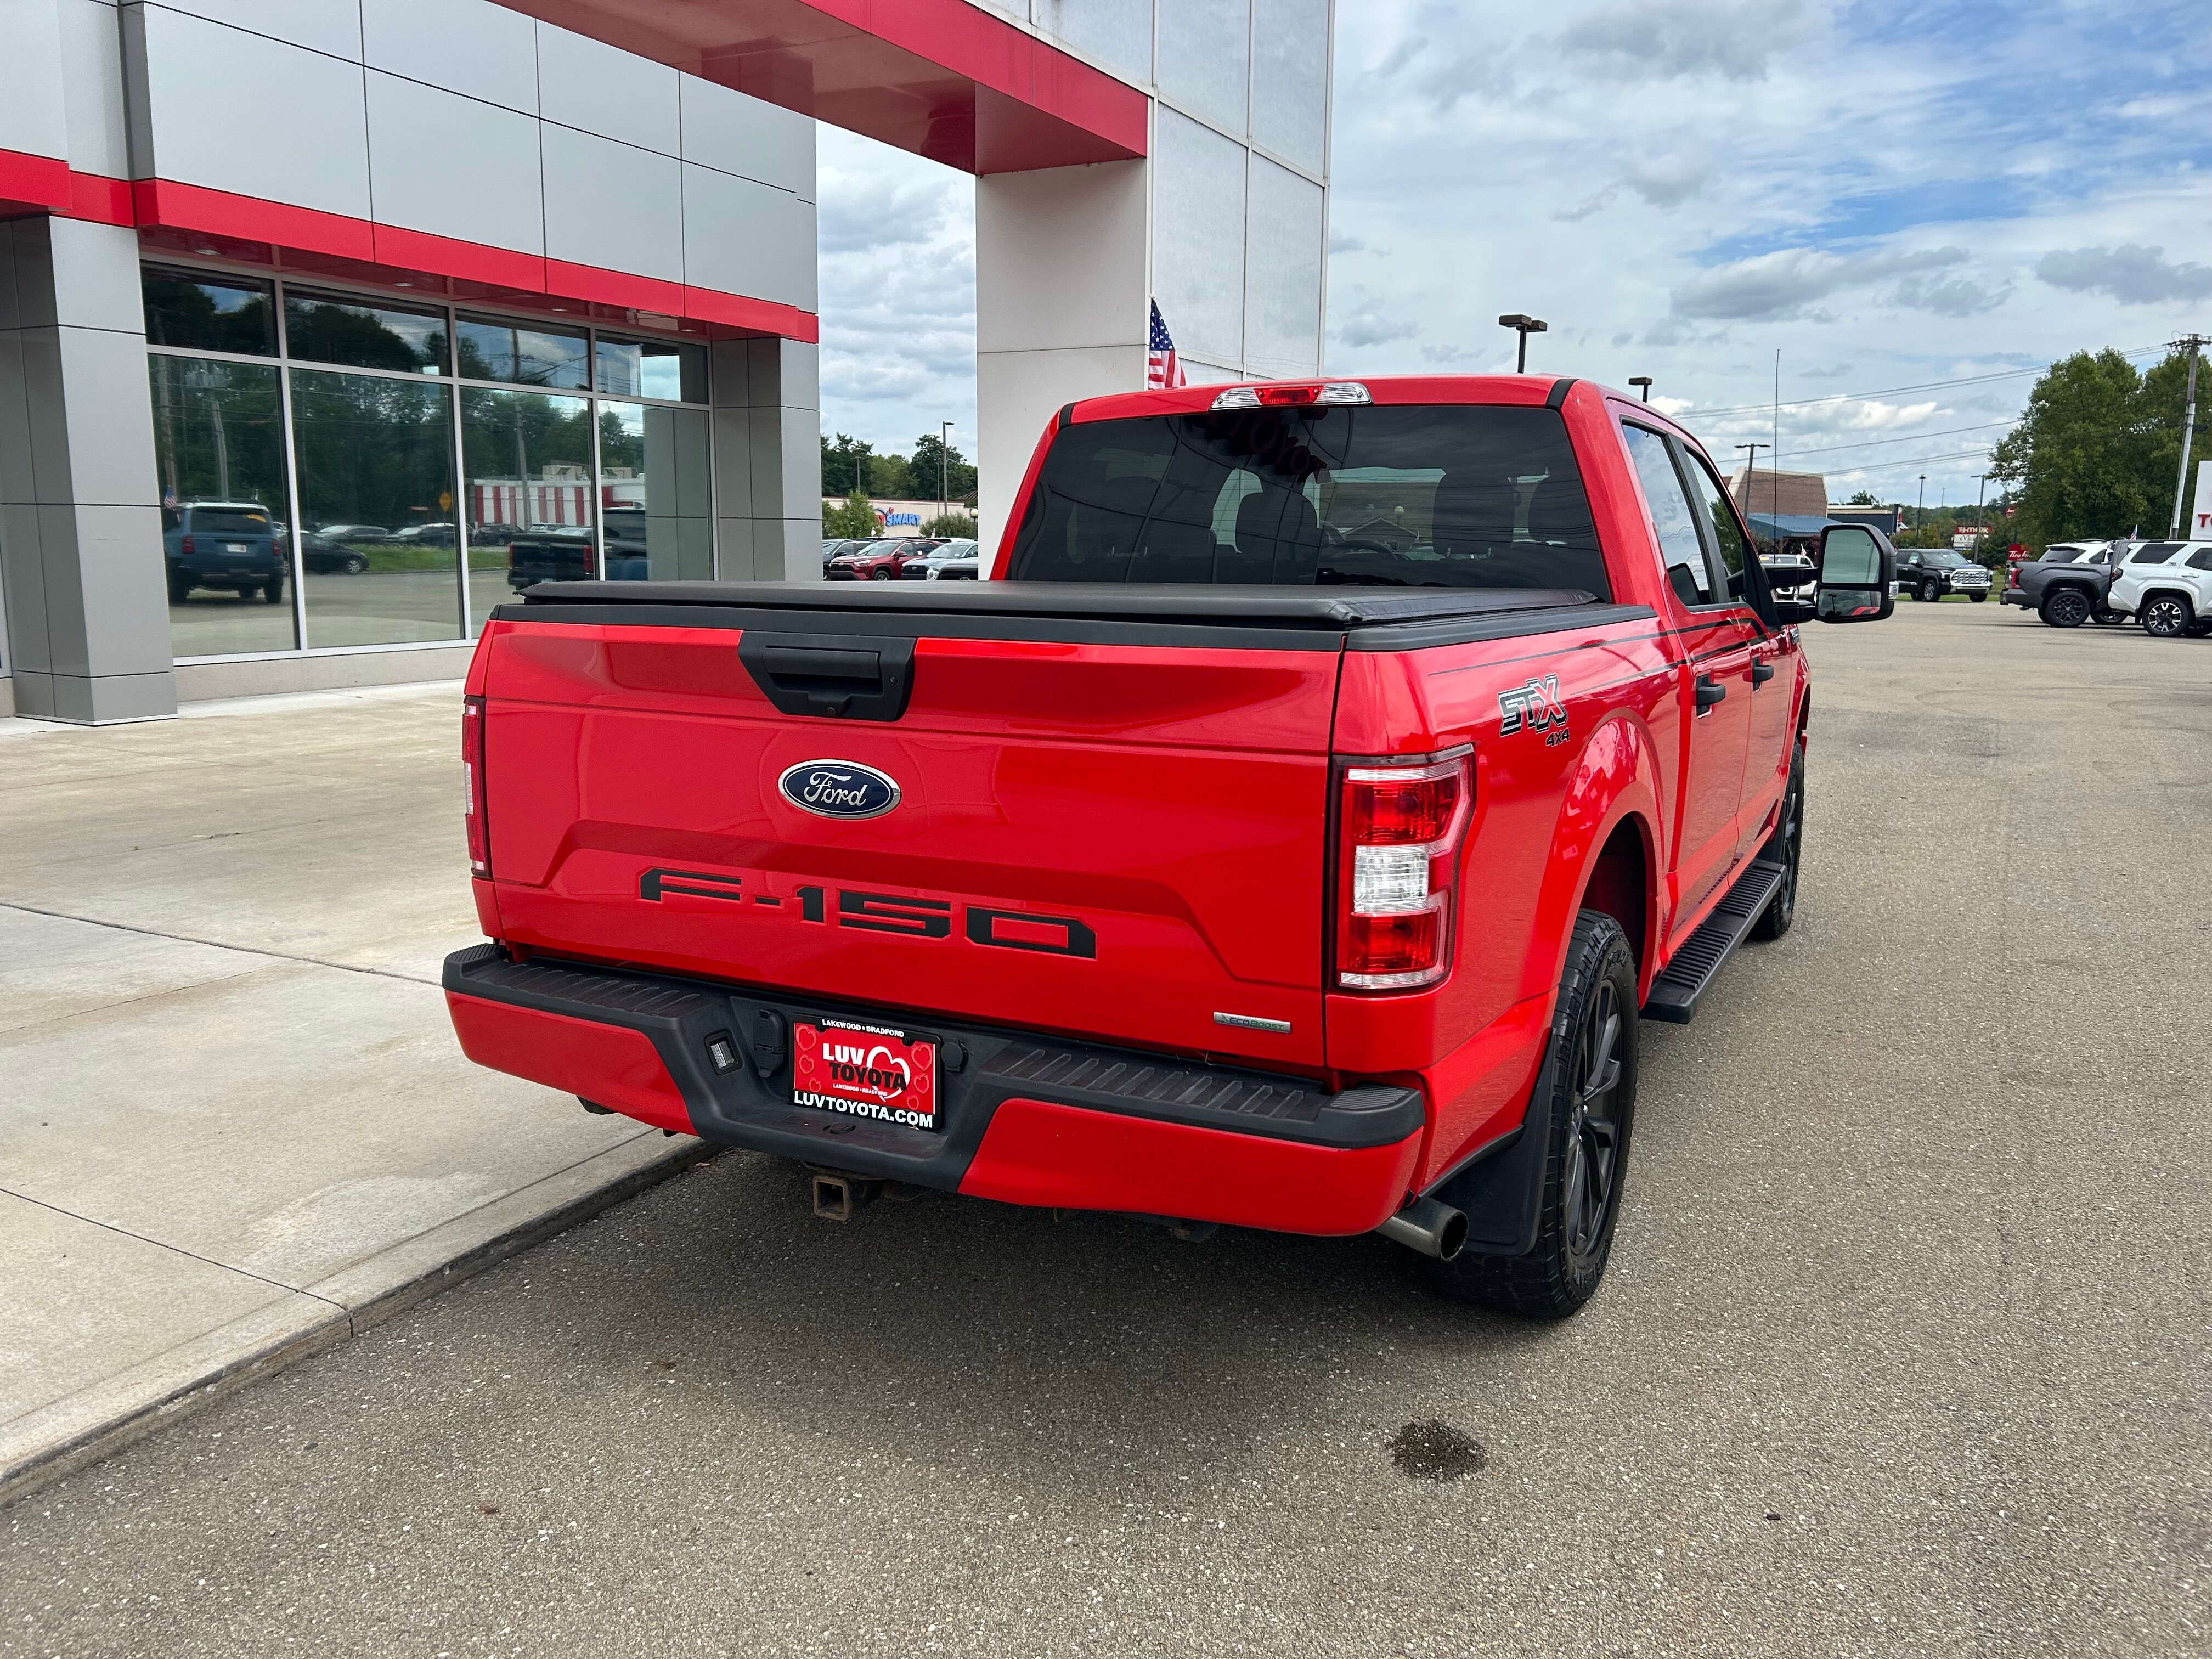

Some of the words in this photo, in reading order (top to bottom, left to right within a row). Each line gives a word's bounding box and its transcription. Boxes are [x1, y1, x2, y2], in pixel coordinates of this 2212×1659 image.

[1498, 673, 1568, 737] STX
[803, 770, 868, 808] Ford
[640, 867, 1097, 960] F-150
[822, 1019, 861, 1030] LAKEWOOD
[866, 1026, 904, 1037] BRADFORD
[823, 1043, 865, 1065] LUV
[829, 1062, 907, 1091] TOYOTA
[833, 1083, 859, 1092] LAKEWOOD
[862, 1088, 888, 1097] BRADFORD
[794, 1091, 933, 1128] LUVTOYOTA.COM
